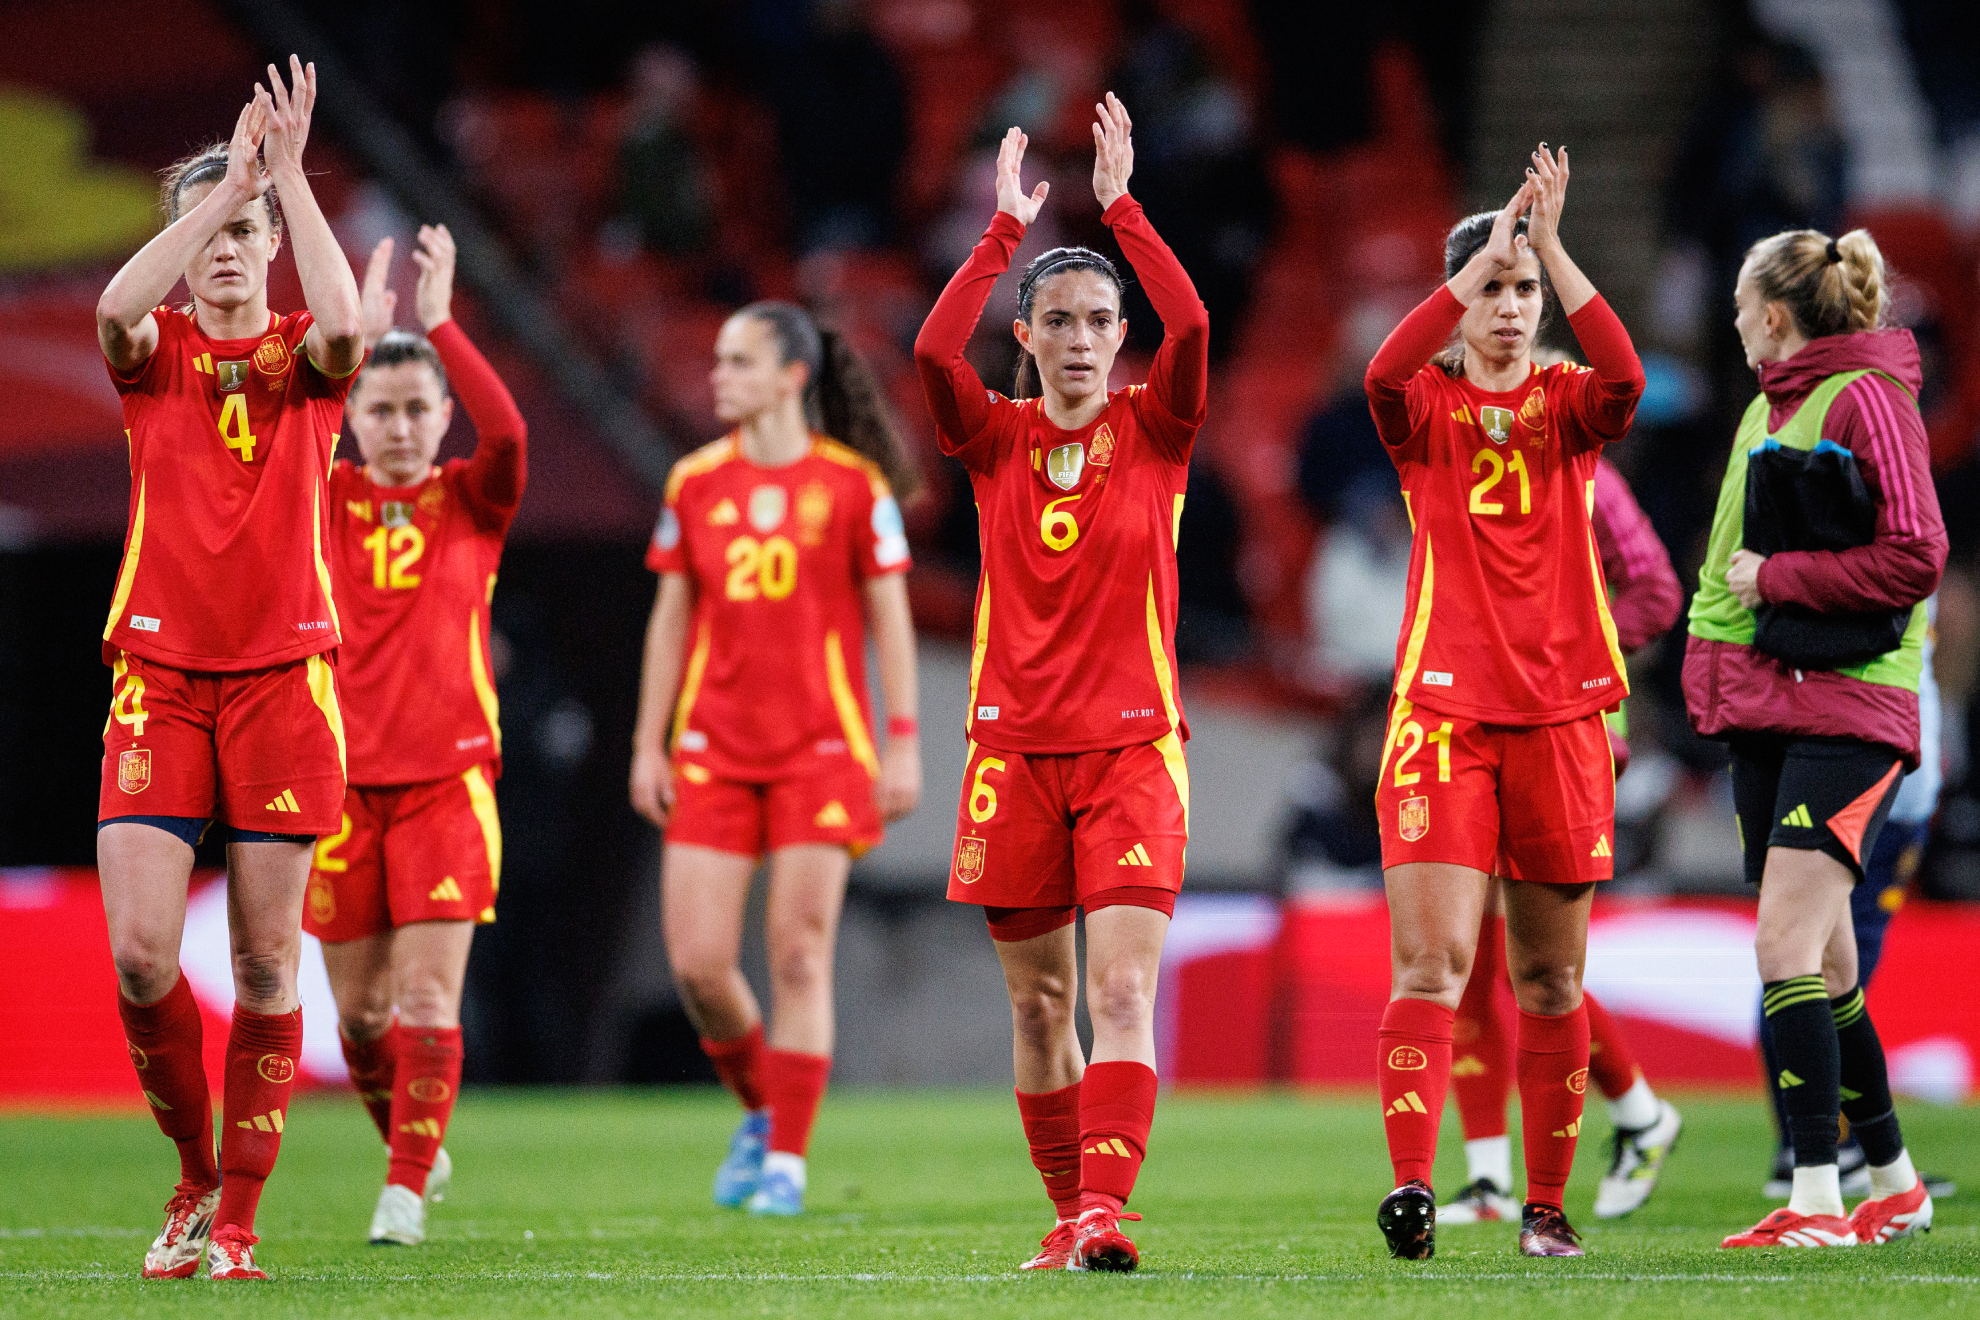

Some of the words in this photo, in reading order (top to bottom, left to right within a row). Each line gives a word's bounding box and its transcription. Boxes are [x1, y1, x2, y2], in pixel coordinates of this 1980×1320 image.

[218, 393, 257, 462] 4
[1469, 448, 1531, 515] 21
[1041, 493, 1082, 552] 6
[363, 525, 425, 589] 12
[725, 535, 798, 601] 20
[298, 621, 328, 630] HEAT.RDY
[114, 675, 149, 736] 4
[1121, 708, 1155, 719] HEAT.RDY
[1394, 720, 1454, 787] 21
[968, 756, 1006, 823] 6
[316, 811, 353, 871] 2
